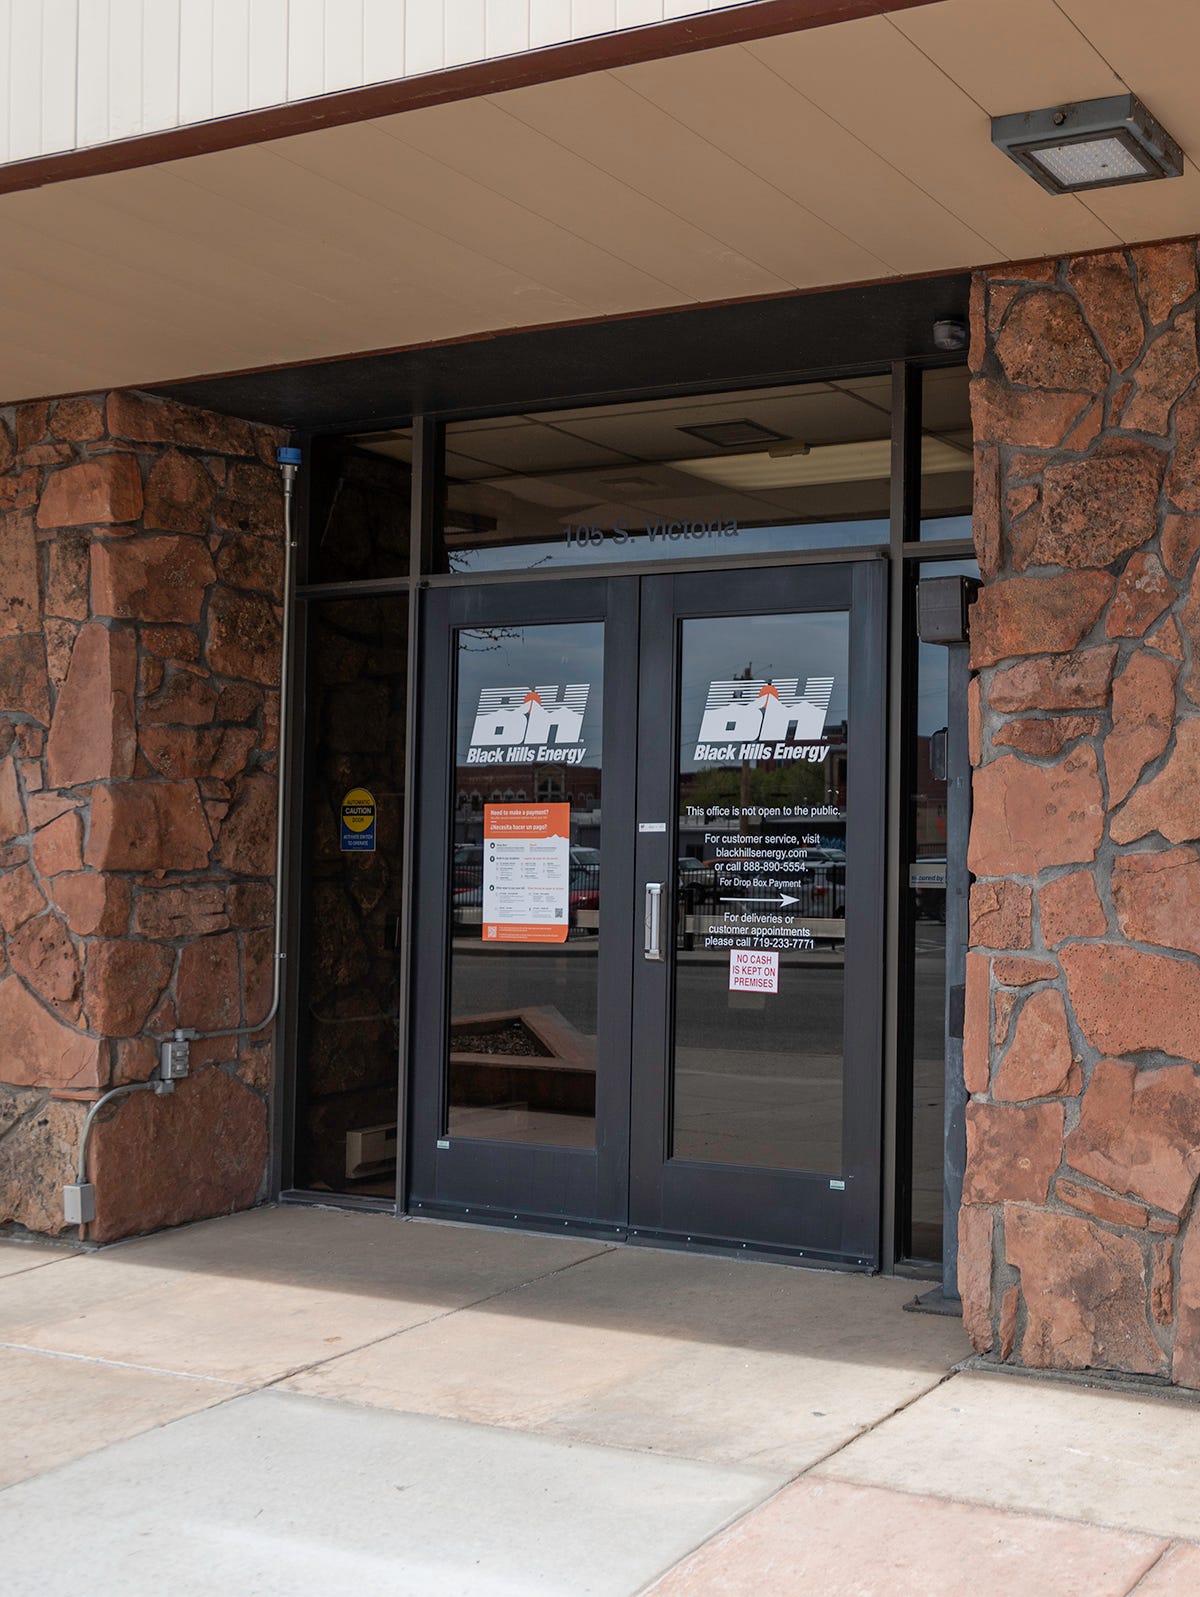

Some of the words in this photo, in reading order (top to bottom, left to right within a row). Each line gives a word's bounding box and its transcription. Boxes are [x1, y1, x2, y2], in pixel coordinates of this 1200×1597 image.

[564, 524, 604, 548] 105
[613, 519, 635, 545] S.
[644, 512, 739, 542] Victoria
[467, 747, 505, 763] Black
[506, 746, 536, 762] Hills
[536, 746, 586, 764] Energy
[694, 744, 737, 761] Black
[738, 744, 772, 760] Hills
[773, 743, 830, 763] Energy
[686, 806, 704, 816] This
[706, 805, 730, 816] office
[732, 806, 740, 816] is
[742, 807, 756, 816] not
[759, 807, 781, 818] open
[783, 806, 792, 816] to
[794, 805, 808, 816] the
[810, 805, 840, 818] public.
[705, 834, 720, 843] For
[722, 835, 763, 844] customer
[764, 834, 799, 845] service,
[802, 834, 820, 844] visit
[716, 847, 808, 860] blackhillsenergy.com
[714, 863, 725, 871] or
[726, 862, 741, 871] call
[743, 862, 808, 872] 888-890-5554.
[719, 878, 732, 886] For
[734, 878, 751, 889] Drop
[753, 878, 767, 887] Box
[769, 879, 801, 889] Payment
[724, 913, 738, 922] For
[740, 913, 783, 924] deliveries
[785, 915, 794, 924] or
[708, 926, 749, 935] customer
[750, 926, 811, 937] appointments
[705, 936, 733, 948] please
[736, 937, 751, 947] call
[753, 938, 814, 949] 719-233-7771
[736, 954, 749, 964] NO
[750, 955, 772, 965] CASH
[732, 965, 740, 974] IS
[741, 966, 762, 976] KEPT
[764, 967, 776, 977] ON
[734, 977, 774, 988] PREMISES
